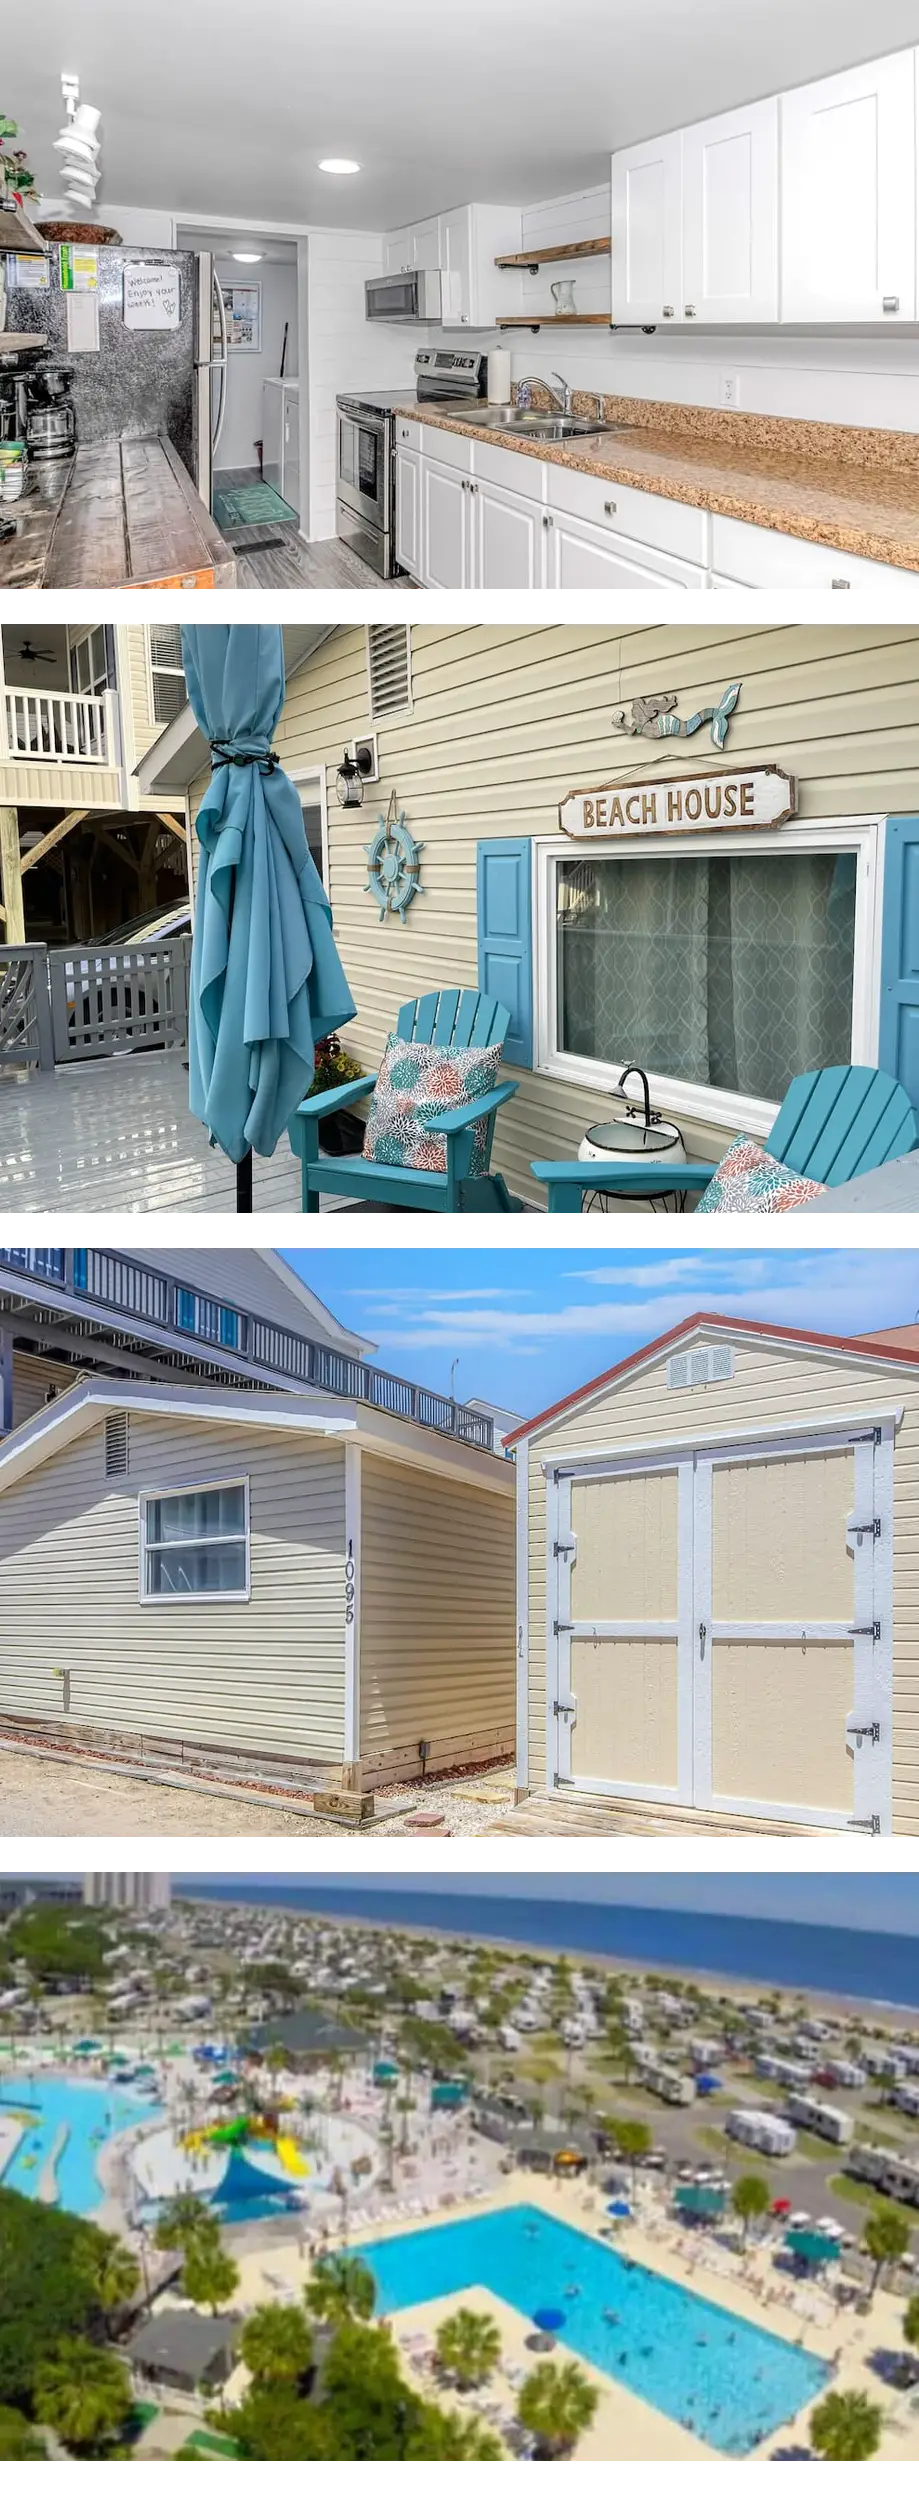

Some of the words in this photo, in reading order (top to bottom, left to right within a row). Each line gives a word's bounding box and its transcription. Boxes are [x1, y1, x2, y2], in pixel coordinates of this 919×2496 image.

[127, 289, 153, 298] Enjoy
[155, 288, 175, 296] your
[583, 792, 657, 829] BEACH
[667, 782, 754, 821] HOUSE
[345, 1539, 354, 1625] 1095
